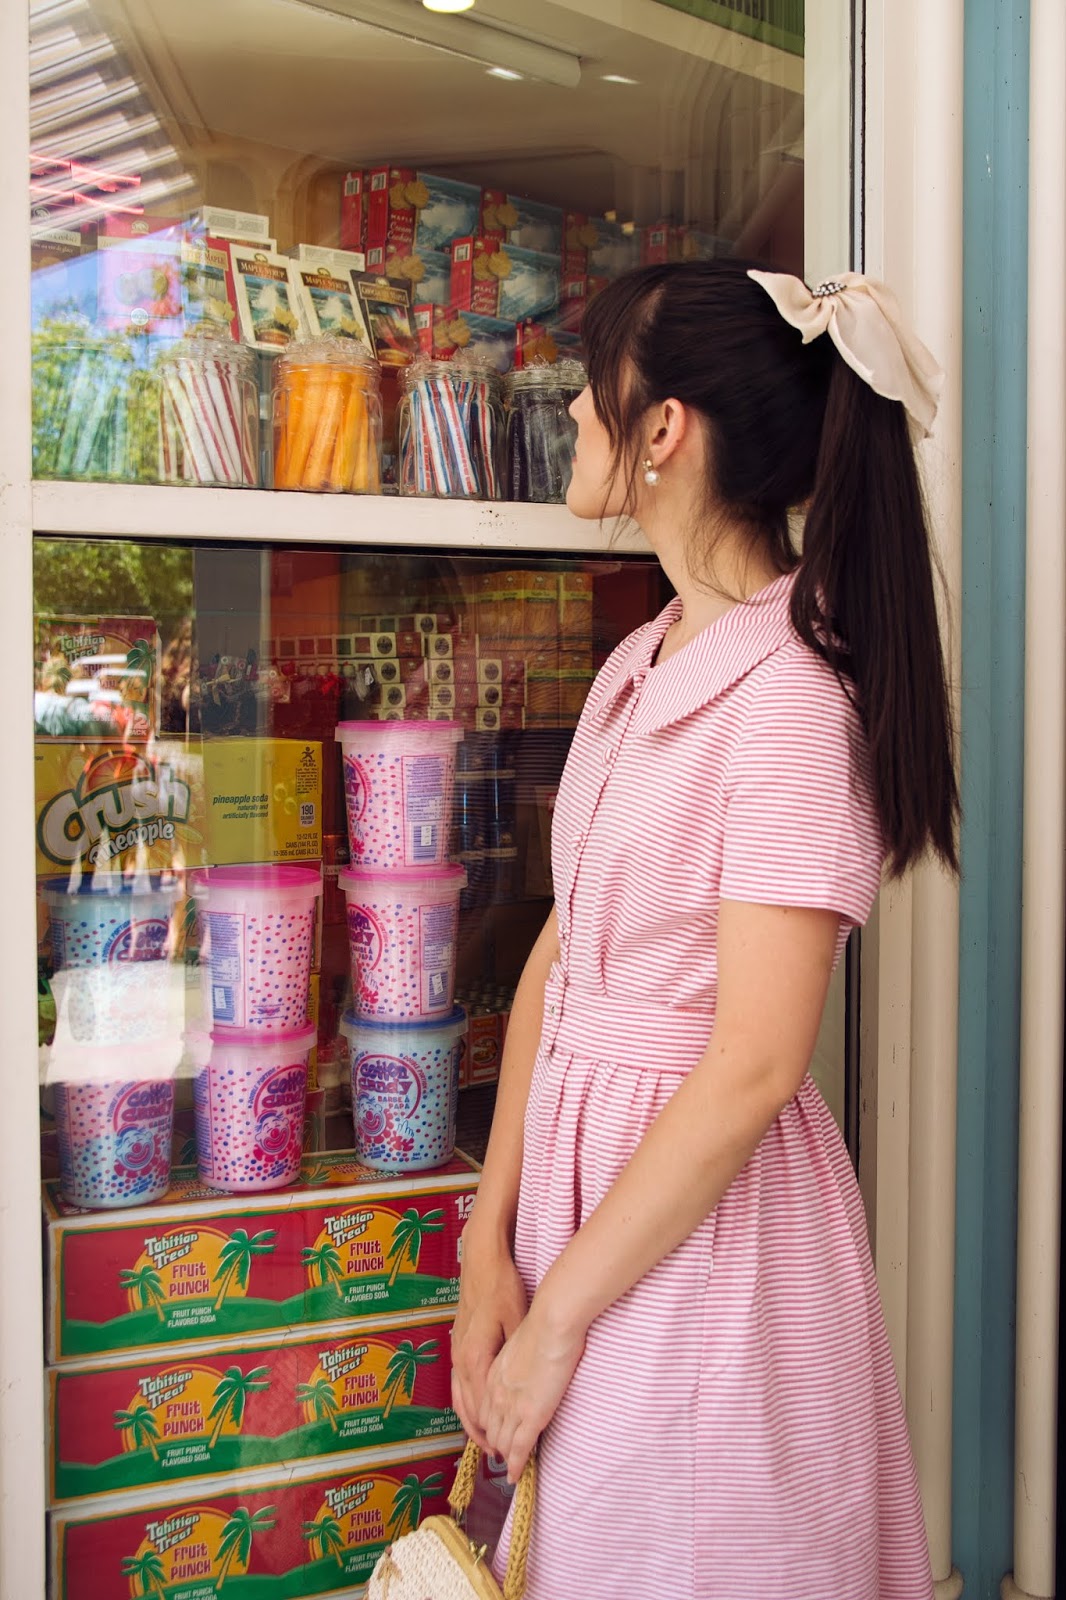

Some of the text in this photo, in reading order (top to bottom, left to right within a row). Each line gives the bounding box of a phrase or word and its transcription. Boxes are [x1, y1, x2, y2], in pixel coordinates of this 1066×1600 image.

[240, 262, 262, 274] MAPLE
[263, 266, 285, 278] SYRUP
[305, 275, 326, 287] MAPLE
[56, 634, 106, 651] Tahitian
[213, 793, 269, 806] pineapple soda
[40, 763, 190, 863] Crush
[301, 804, 313, 815] 190
[454, 1194, 476, 1213] 12
[324, 1211, 374, 1235] Tahitian
[458, 1212, 472, 1220] PAC
[144, 1231, 198, 1256] Tahitian
[333, 1224, 367, 1248] Treat
[153, 1245, 191, 1269] Treat
[349, 1239, 381, 1257] Fruit
[172, 1261, 206, 1279] Fruit
[347, 1256, 384, 1274] PUNCH
[169, 1279, 210, 1297] PUNCH
[349, 1282, 385, 1294] FRUIT PUNCH
[449, 1277, 460, 1285] 12-1
[344, 1291, 389, 1304] FLAVORED SODA
[421, 1296, 438, 1305] 12-355
[448, 1294, 460, 1302] CAN
[436, 1286, 450, 1295] CANS
[172, 1306, 212, 1318] FRUIT PUNCH
[167, 1315, 216, 1328] FLAVORED SODA
[319, 1345, 368, 1369] Tahitian
[328, 1357, 362, 1382] Treat
[139, 1370, 193, 1396] Tahitian
[345, 1374, 376, 1391] Fruit
[148, 1384, 185, 1409] Treat
[341, 1389, 379, 1408] PUNCH
[166, 1400, 200, 1418] Fruit
[163, 1417, 204, 1436] PUNCH
[339, 1423, 384, 1437] FLAVORED SODA
[344, 1415, 380, 1428] FRUIT PUNCH
[415, 1427, 432, 1436] 12-355
[442, 1424, 456, 1432] CANS
[430, 1417, 445, 1426] CANS
[162, 1453, 210, 1467] FLAVORED SODA
[167, 1445, 206, 1457] FRUIT PUNCH
[325, 1480, 374, 1507] Tahitian
[333, 1493, 367, 1519] Treat
[146, 1513, 200, 1541] Tahitian
[350, 1510, 382, 1528] Fruit
[155, 1527, 192, 1554] Treat
[347, 1524, 384, 1544] PUNCH
[174, 1542, 208, 1561] Fruit
[350, 1554, 365, 1564] FRUIT
[170, 1560, 211, 1580] PUNCH
[345, 1561, 374, 1573] FLAVORED
[174, 1586, 213, 1600] FRUIT PUNCH
